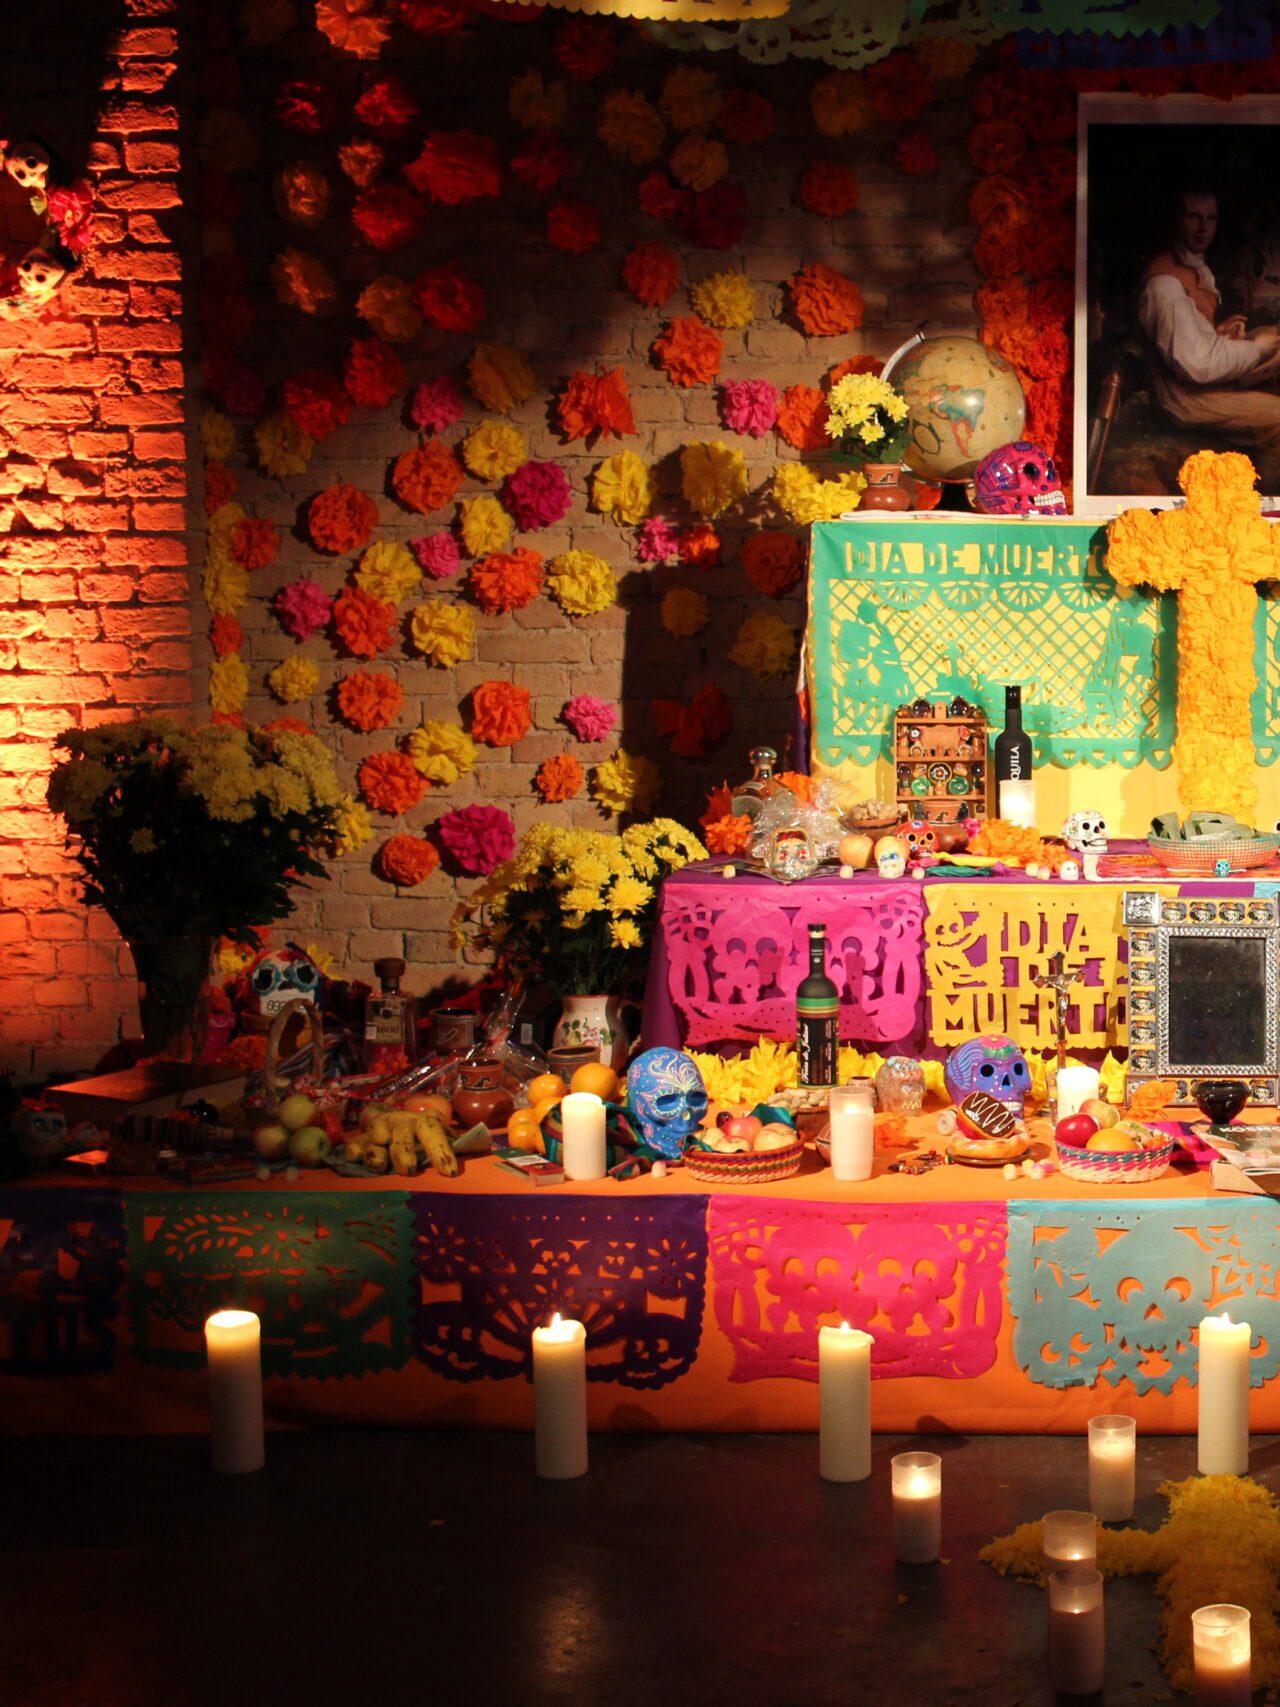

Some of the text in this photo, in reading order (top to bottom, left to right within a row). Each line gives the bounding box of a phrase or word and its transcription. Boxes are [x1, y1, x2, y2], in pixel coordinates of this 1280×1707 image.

[851, 541, 1109, 577] DIA DE MUERTO
[1010, 745, 1022, 781] QUILA
[1008, 912, 1092, 953] DIA
[928, 990, 1129, 1035] MUERTO
